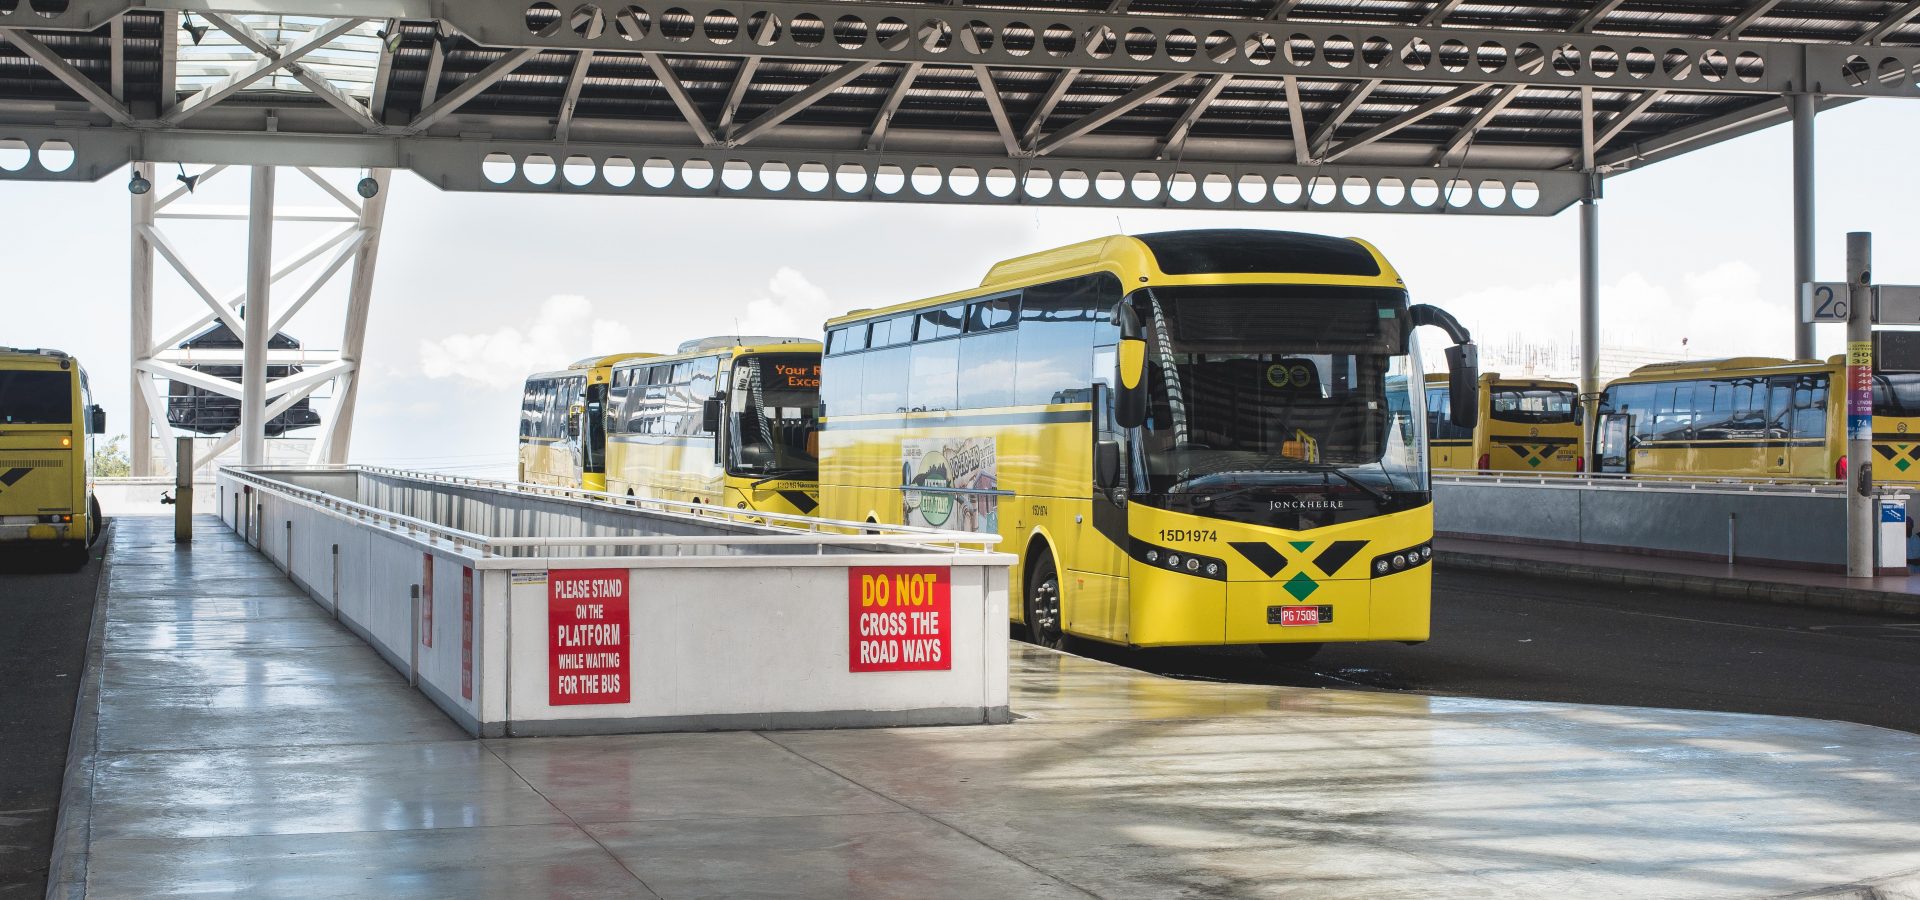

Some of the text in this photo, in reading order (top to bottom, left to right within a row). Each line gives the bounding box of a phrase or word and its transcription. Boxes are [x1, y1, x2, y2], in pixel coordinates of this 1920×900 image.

[775, 364, 808, 375] Your
[788, 376, 820, 387] Exce
[1269, 500, 1344, 511] JONCKHEERE
[1159, 529, 1218, 543] 15D1974
[555, 578, 622, 599] PLEASE STAND
[862, 573, 937, 607] DO NOT
[576, 604, 604, 619] ON THE
[1283, 610, 1317, 622] PG 7509
[860, 612, 939, 637] CROSS THE
[558, 624, 620, 647] PLATFORM
[860, 638, 942, 664] ROAD WAYS
[558, 652, 620, 669] WHILE WAITING
[558, 674, 620, 695] FOR THE BUS
